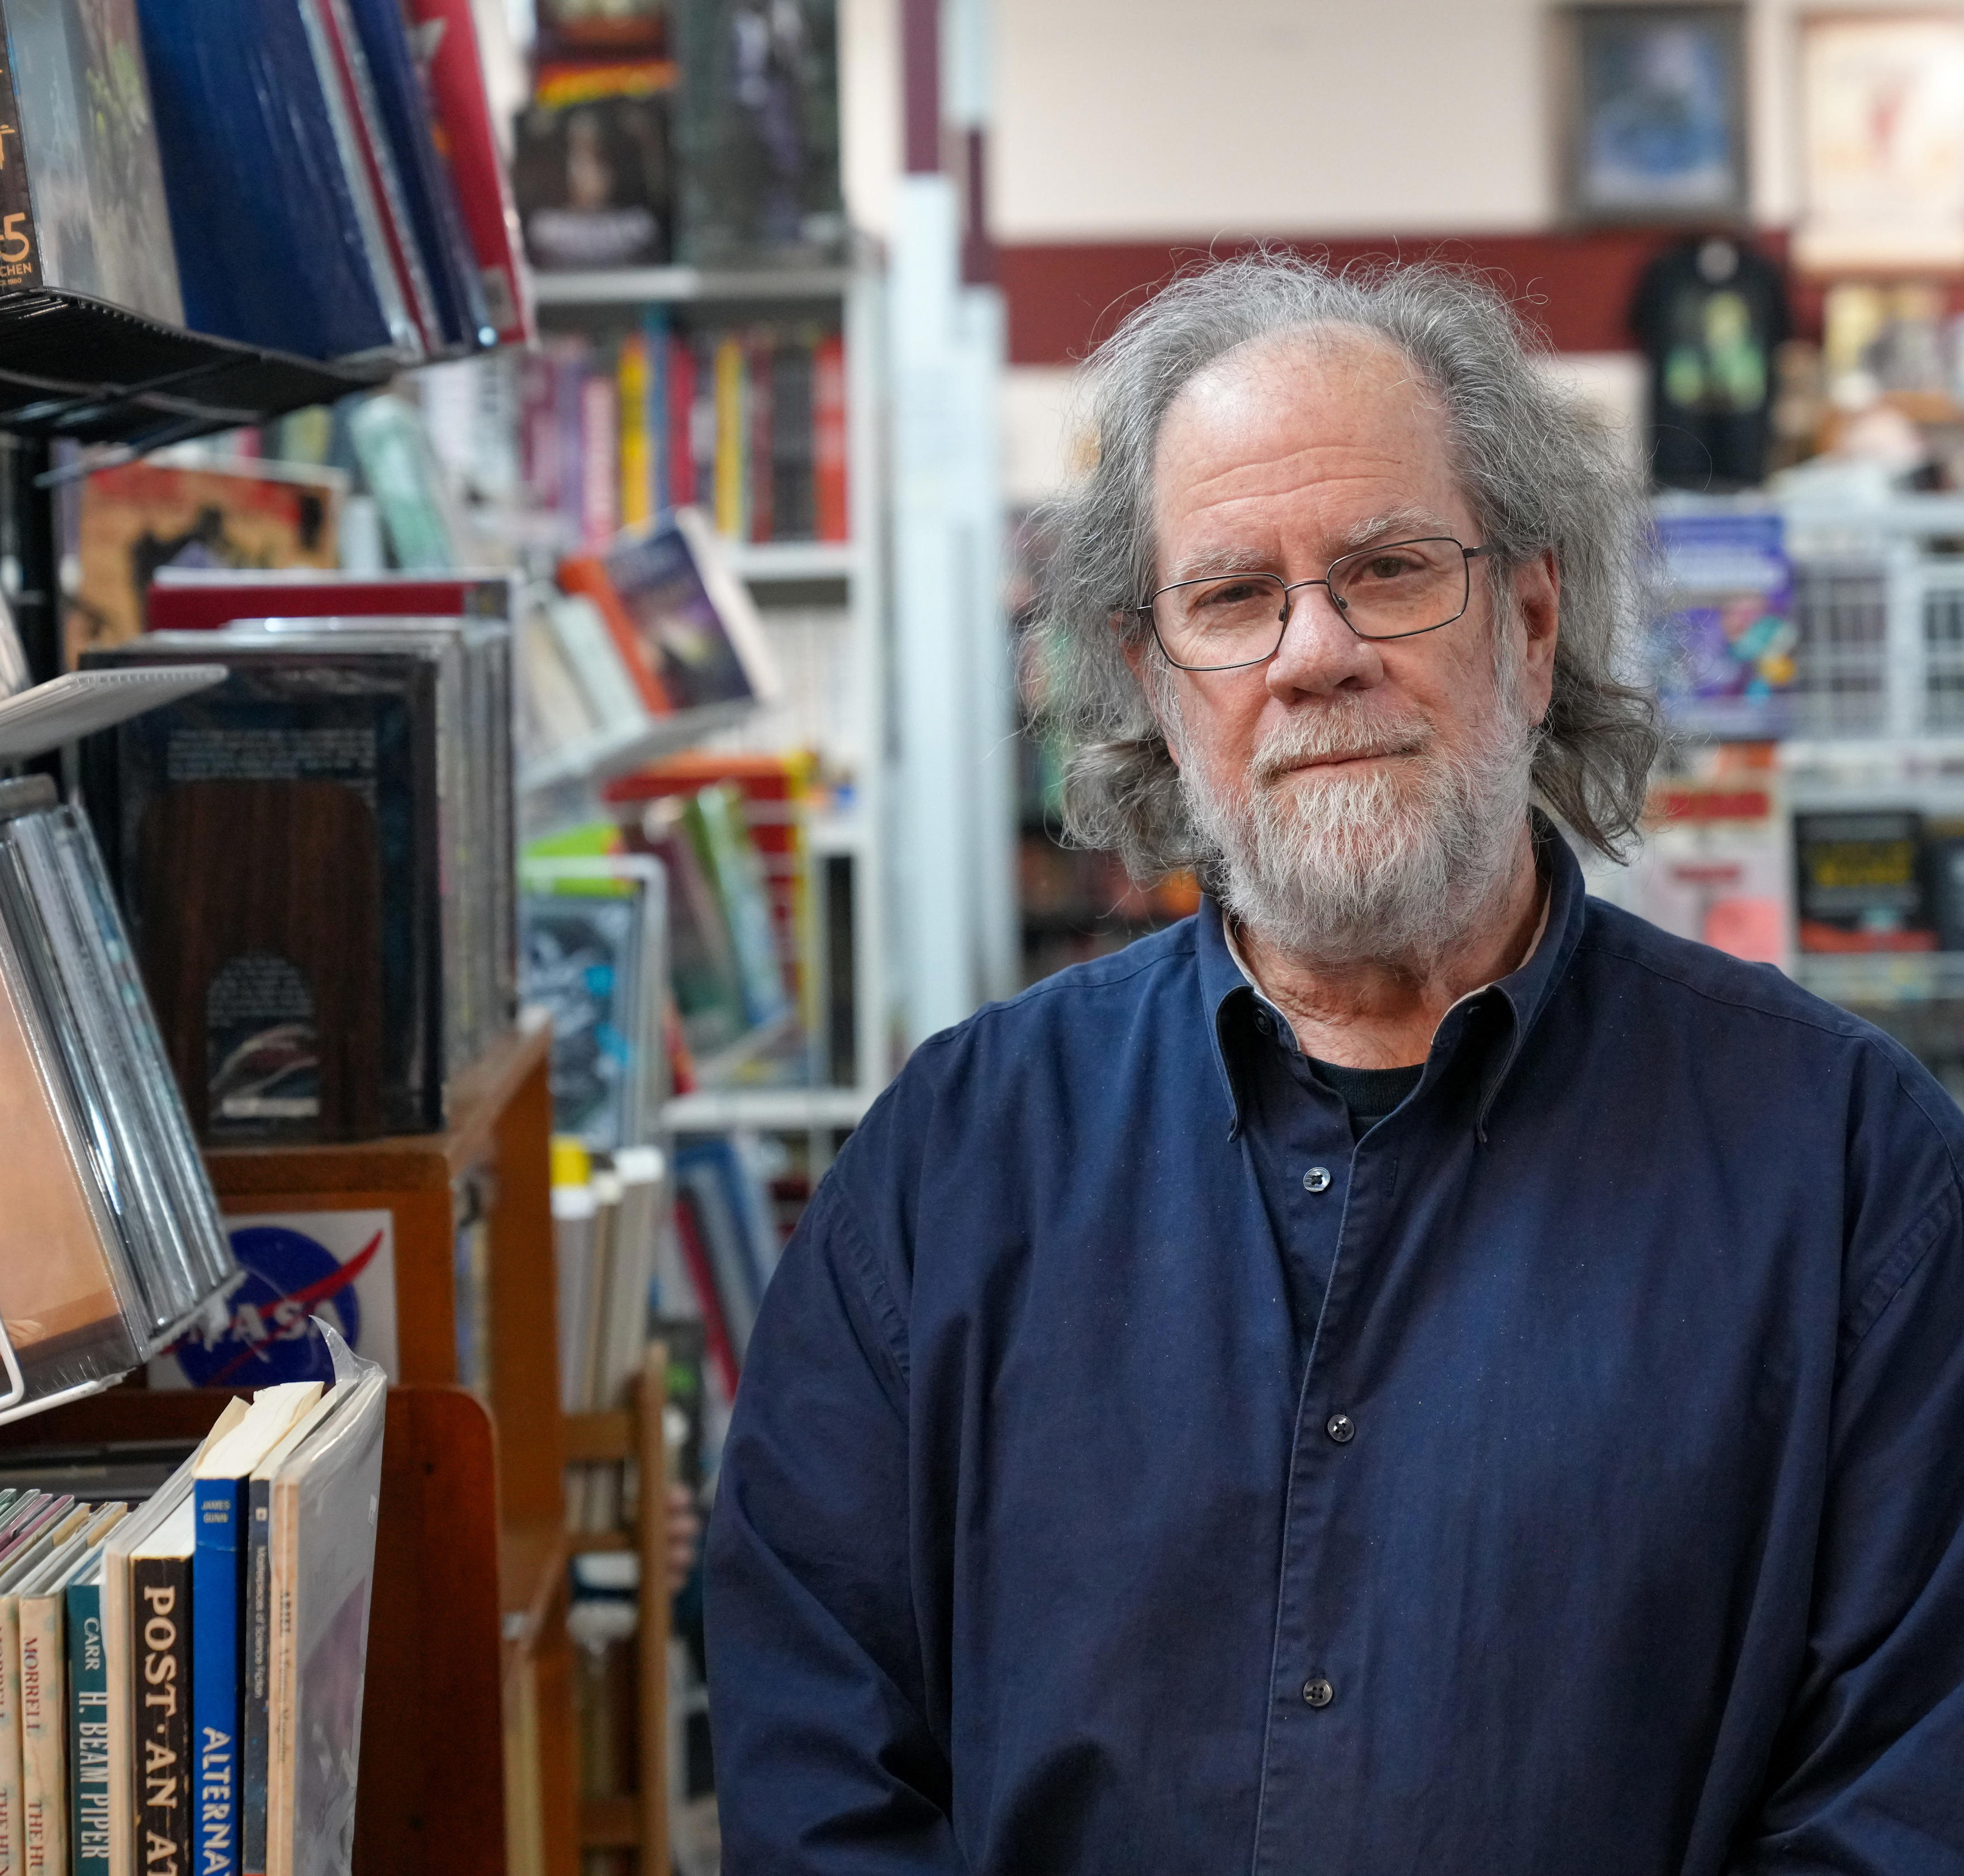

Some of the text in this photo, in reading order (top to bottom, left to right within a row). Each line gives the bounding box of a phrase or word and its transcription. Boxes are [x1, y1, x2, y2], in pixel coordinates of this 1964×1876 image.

[0, 212, 29, 263] 5
[188, 1299, 347, 1346] ASA
[201, 1500, 231, 1511] JAMES
[255, 1545, 267, 1611] Masterpieces
[84, 1617, 101, 1671] CARR
[255, 1624, 265, 1665] Science
[24, 1637, 41, 1738] MORRELL
[254, 1665, 265, 1698] Fiction
[79, 1691, 110, 1859] H. BEAM PIPER
[29, 1798, 43, 1841] THE
[202, 1726, 232, 1876] ALTERNA
